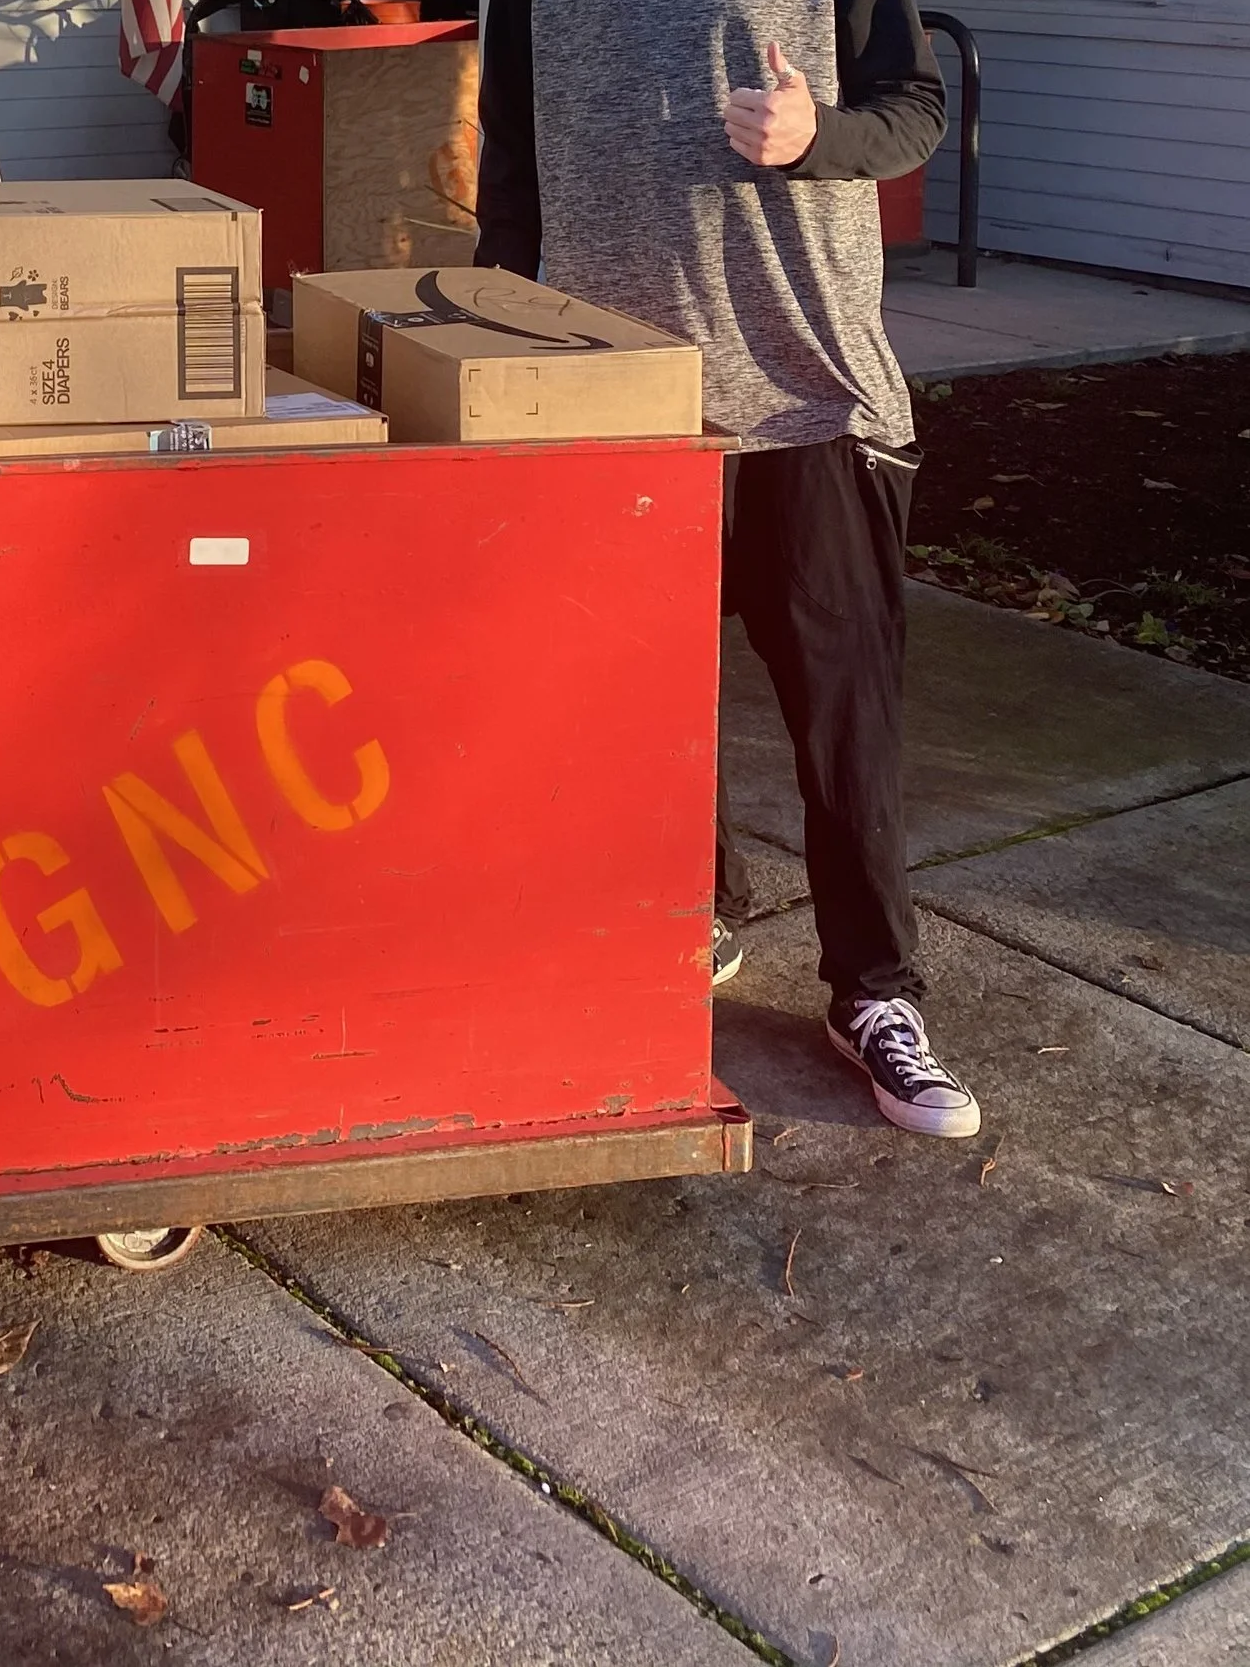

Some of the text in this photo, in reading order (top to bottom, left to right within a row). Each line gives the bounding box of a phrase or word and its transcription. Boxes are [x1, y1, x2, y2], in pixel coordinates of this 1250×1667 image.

[60, 276, 70, 310] BEARS
[42, 359, 56, 405] SIZE 4
[56, 338, 70, 405] DIAPERS
